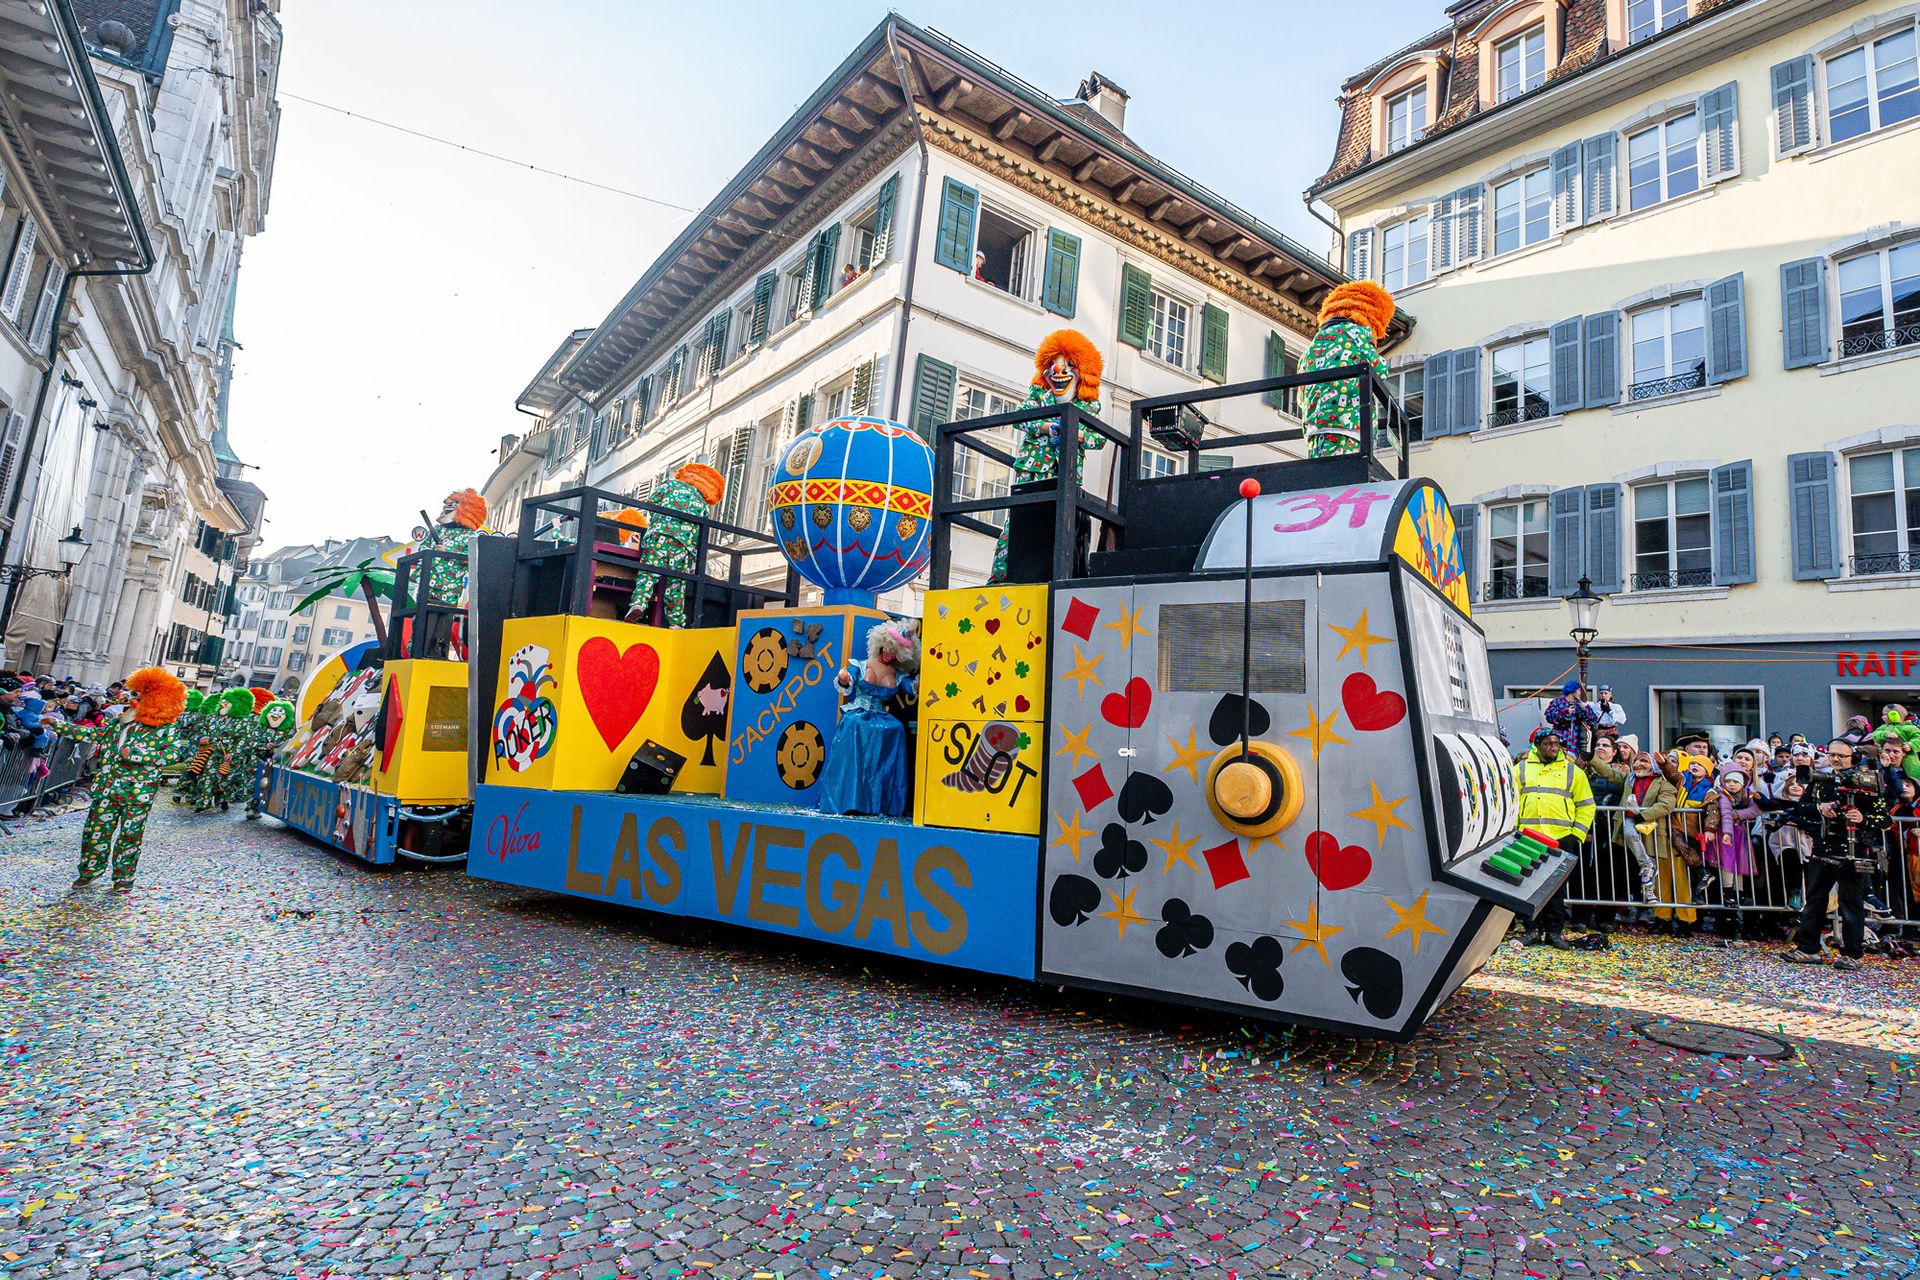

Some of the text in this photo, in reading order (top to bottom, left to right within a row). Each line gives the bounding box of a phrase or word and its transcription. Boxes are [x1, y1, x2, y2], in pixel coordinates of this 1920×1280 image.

[1836, 650, 1919, 676] RAIF
[494, 699, 554, 771] POKER
[732, 641, 835, 765] JACKPOT
[943, 722, 1038, 808] SLOT
[289, 781, 334, 838] ZUCHU
[486, 801, 540, 863] Viva
[565, 804, 973, 955] LAS VEGAS
